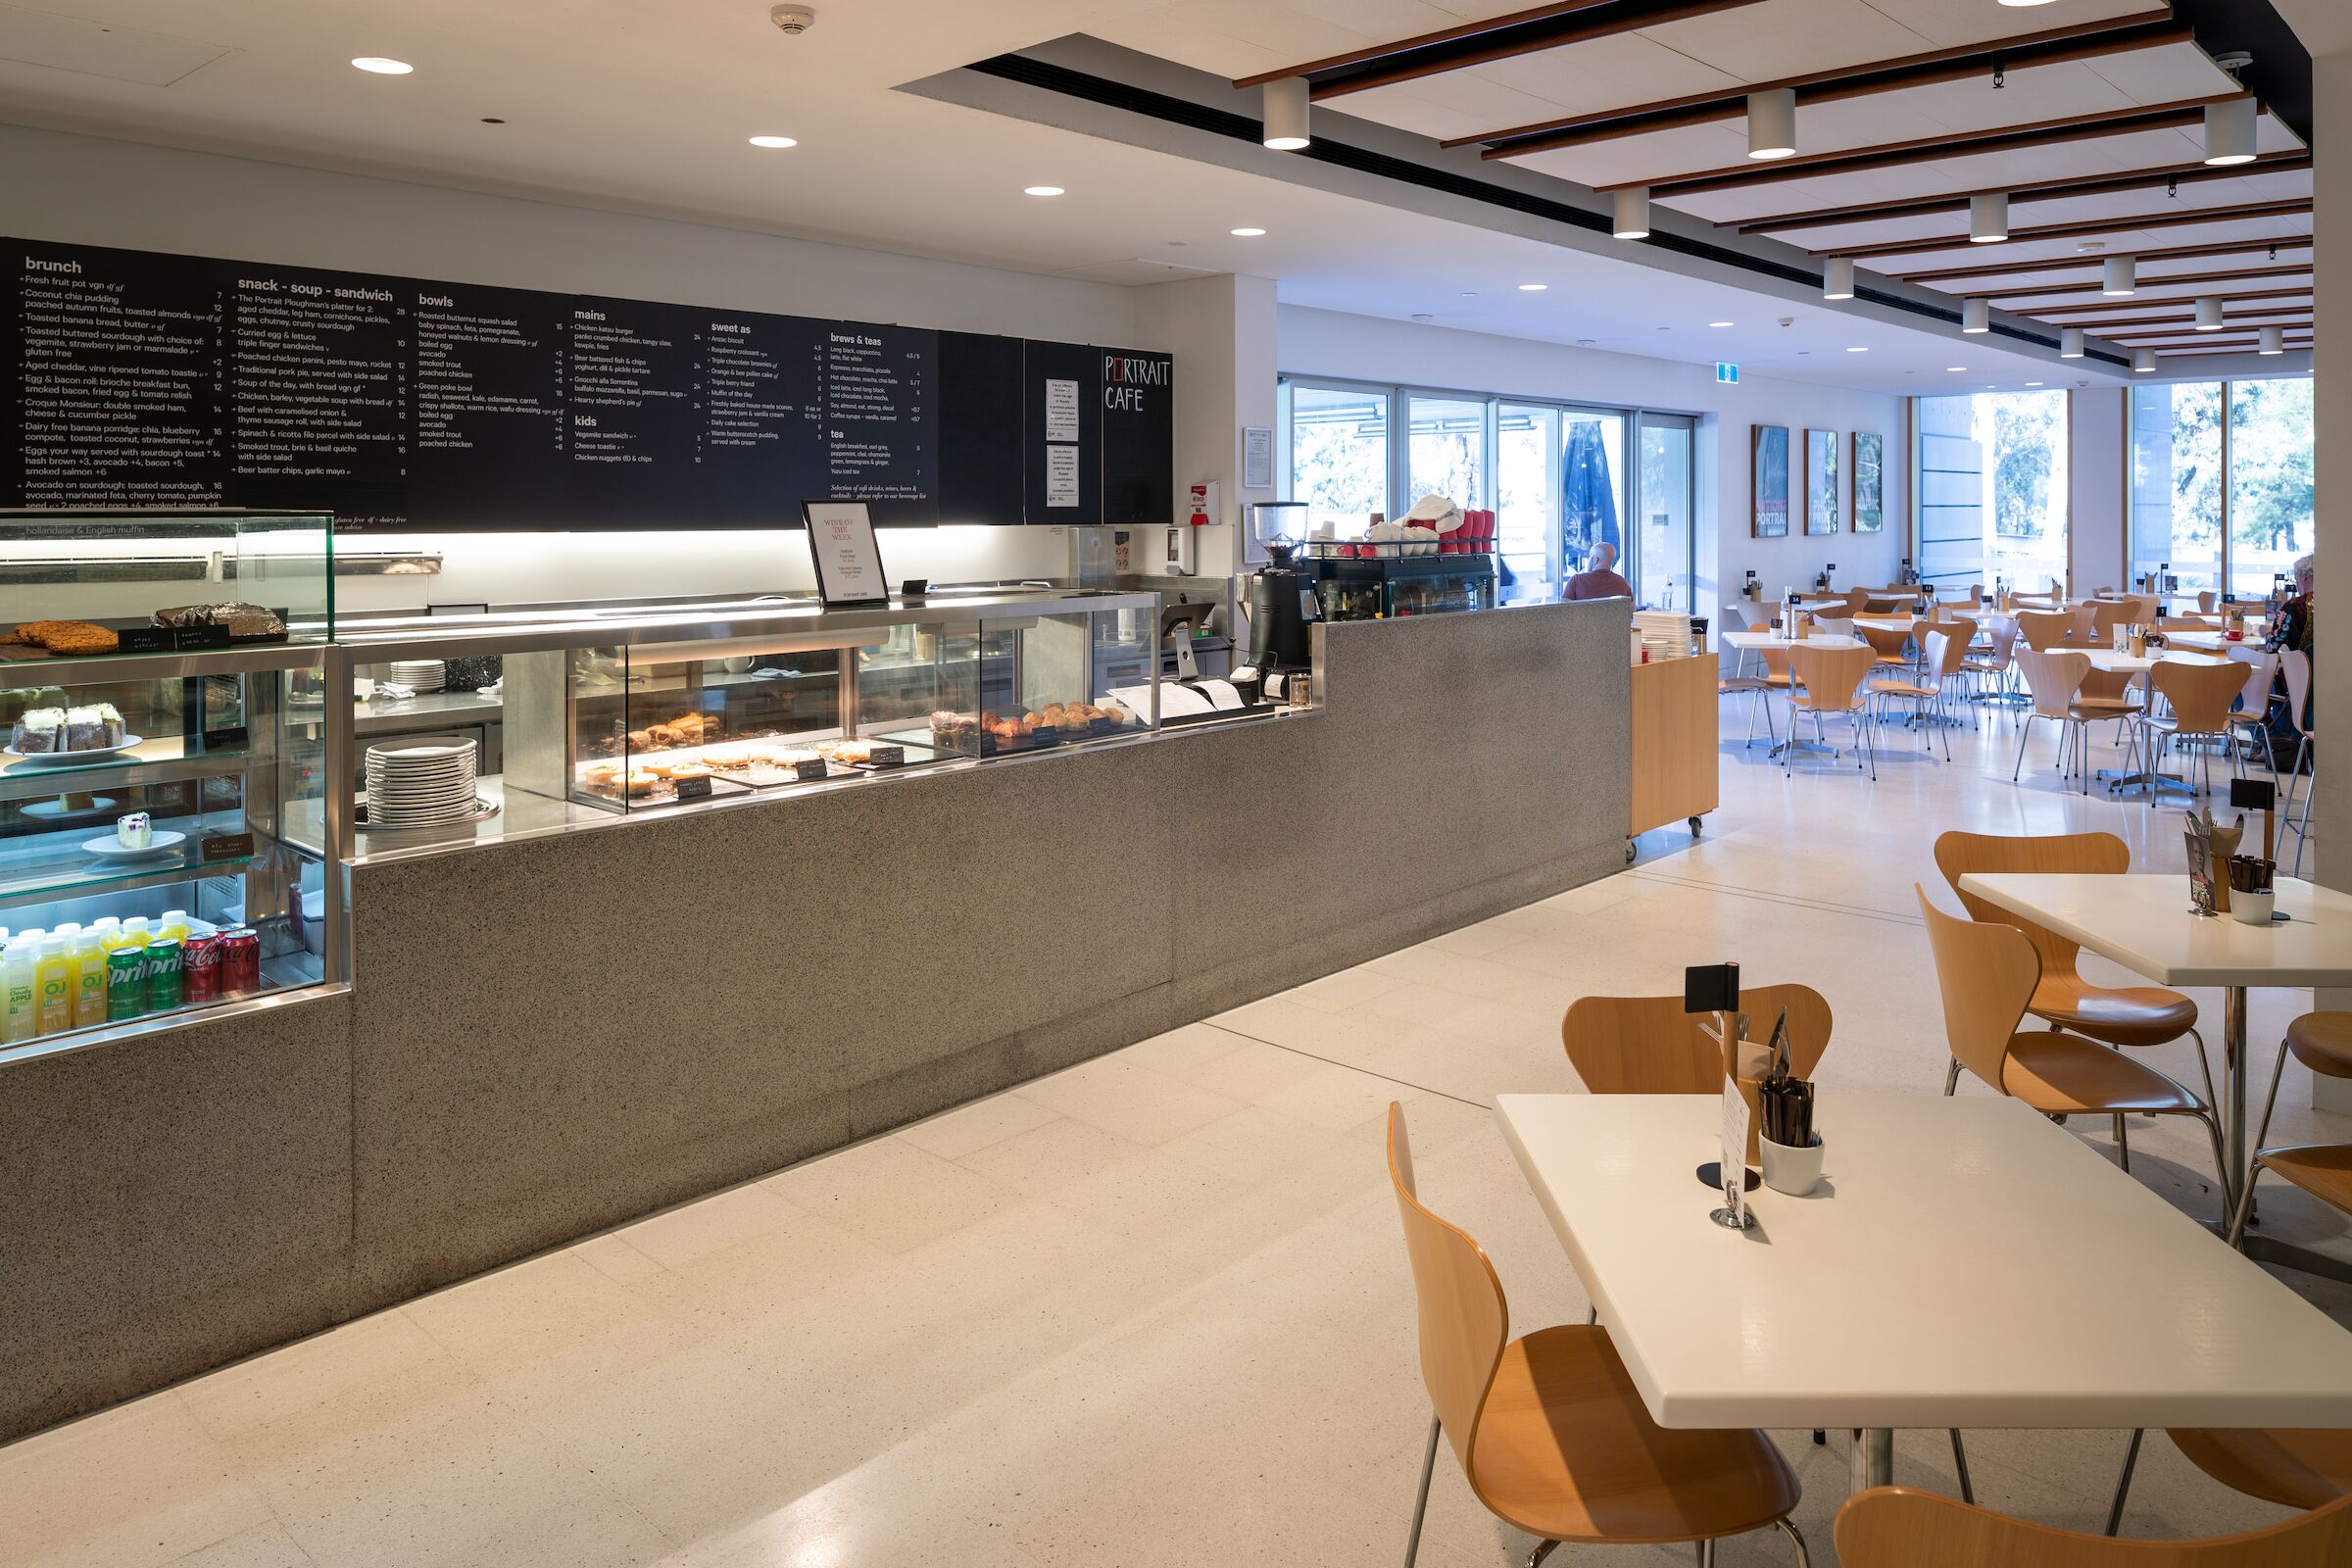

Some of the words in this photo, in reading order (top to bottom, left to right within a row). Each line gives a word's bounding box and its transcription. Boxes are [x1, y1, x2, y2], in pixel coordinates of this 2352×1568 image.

[25, 257, 81, 273] brunch
[25, 275, 49, 284] Fresh
[52, 277, 70, 286] fruit
[238, 279, 277, 291] snack
[291, 284, 322, 297] soup
[334, 288, 393, 301] sandwich
[24, 289, 62, 299] Coconut
[65, 292, 82, 301] chia
[84, 295, 119, 305] pudding
[255, 296, 282, 305] Portrait
[284, 299, 329, 309] Ploughman's
[419, 294, 453, 307] bowls
[125, 308, 156, 317] toasted
[158, 310, 191, 318] almonds
[575, 311, 606, 320] mains
[25, 326, 60, 336] Toasted
[63, 329, 99, 338] buttered
[102, 333, 145, 342] sourdough
[711, 323, 738, 332] sweet
[237, 328, 266, 337] Curried
[291, 332, 317, 341] lettuce
[831, 333, 855, 343] brews
[857, 335, 862, 344] &
[864, 337, 881, 346] teas
[238, 352, 270, 361] Poached
[1105, 356, 1170, 385] PORTRAIT
[25, 374, 42, 384] Egg
[133, 379, 171, 388] breakfast
[1105, 386, 1144, 412] CAFE
[575, 416, 597, 426] kids
[25, 446, 47, 456] Eggs
[26, 526, 74, 535] hollandaise
[86, 526, 116, 535] English
[119, 525, 144, 534] muffin
[10, 994, 31, 1003] APPLE
